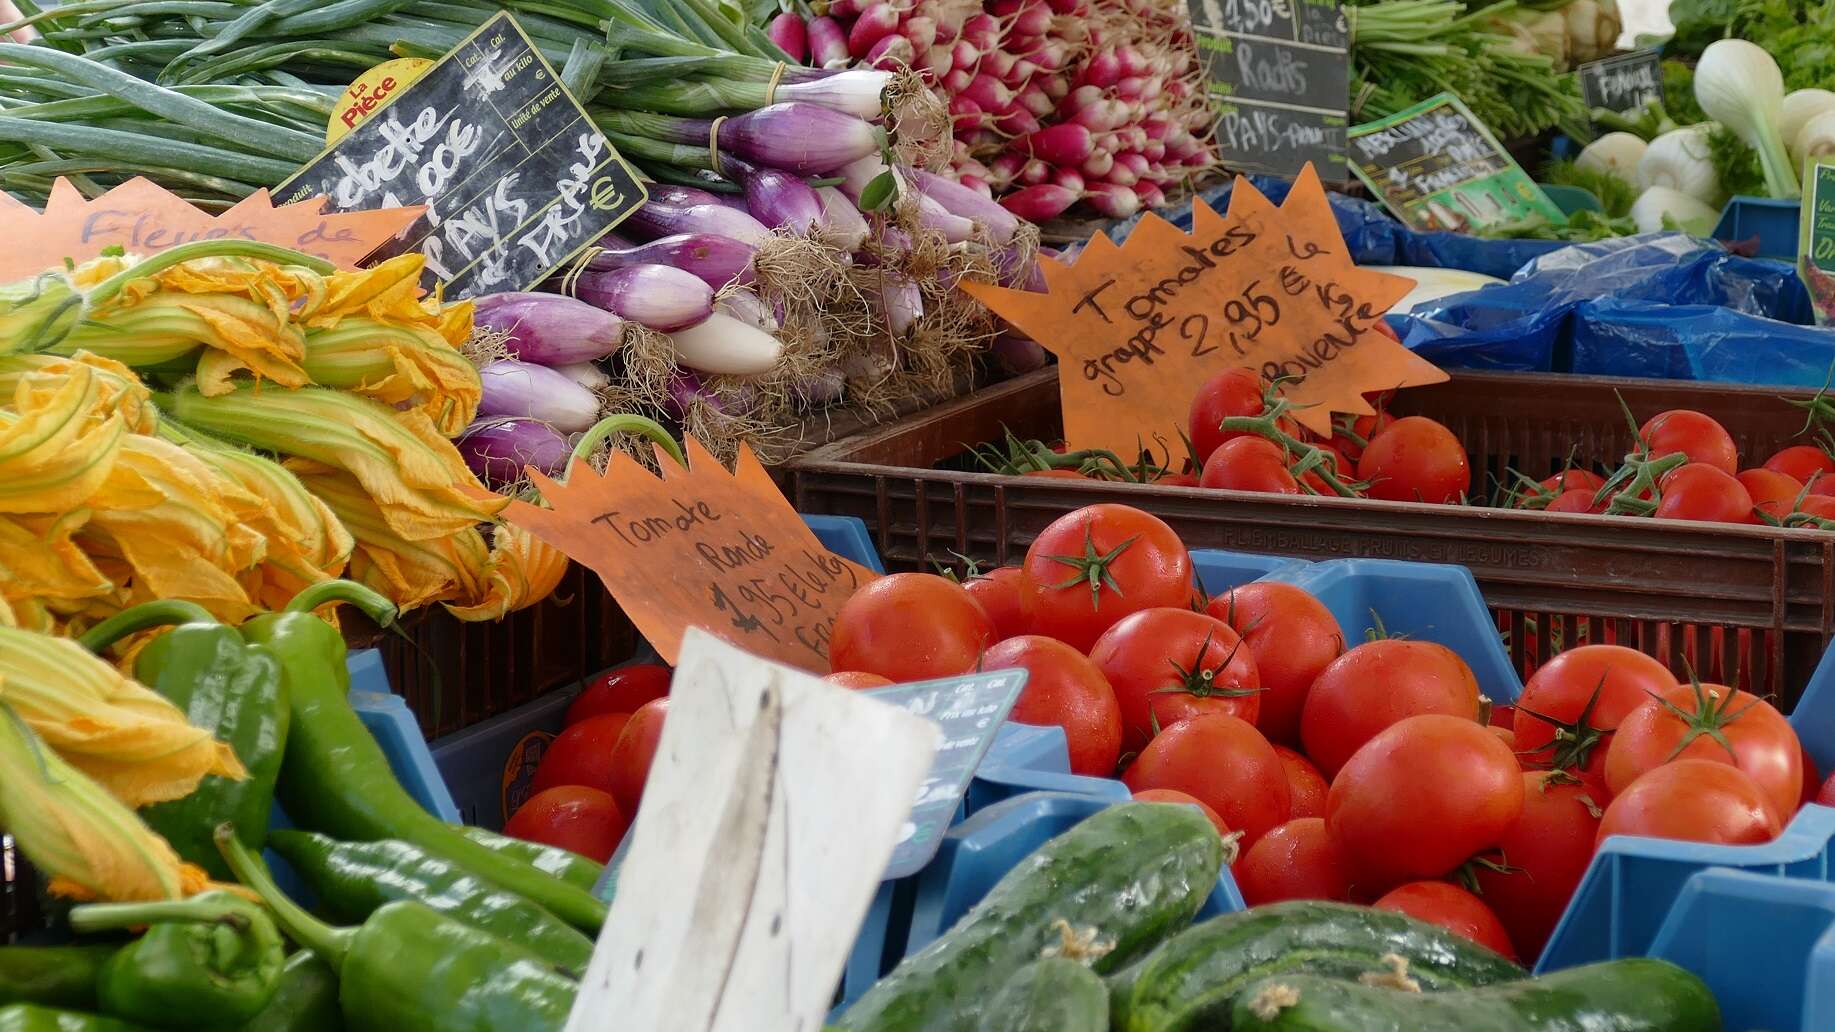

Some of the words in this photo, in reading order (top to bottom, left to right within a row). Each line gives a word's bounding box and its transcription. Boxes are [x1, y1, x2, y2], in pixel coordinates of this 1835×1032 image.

[504, 71, 517, 81] au
[516, 55, 533, 72] kilo
[341, 77, 397, 129] Pièce
[349, 82, 368, 99] La
[511, 109, 532, 129] Unité
[531, 103, 541, 115] de
[540, 87, 561, 107] vente
[588, 175, 624, 211] €
[297, 221, 365, 246] de
[1072, 224, 1256, 324] Tomates
[1082, 311, 1176, 396] grappe
[590, 498, 721, 548] Tomate
[695, 529, 775, 574] Ronde
